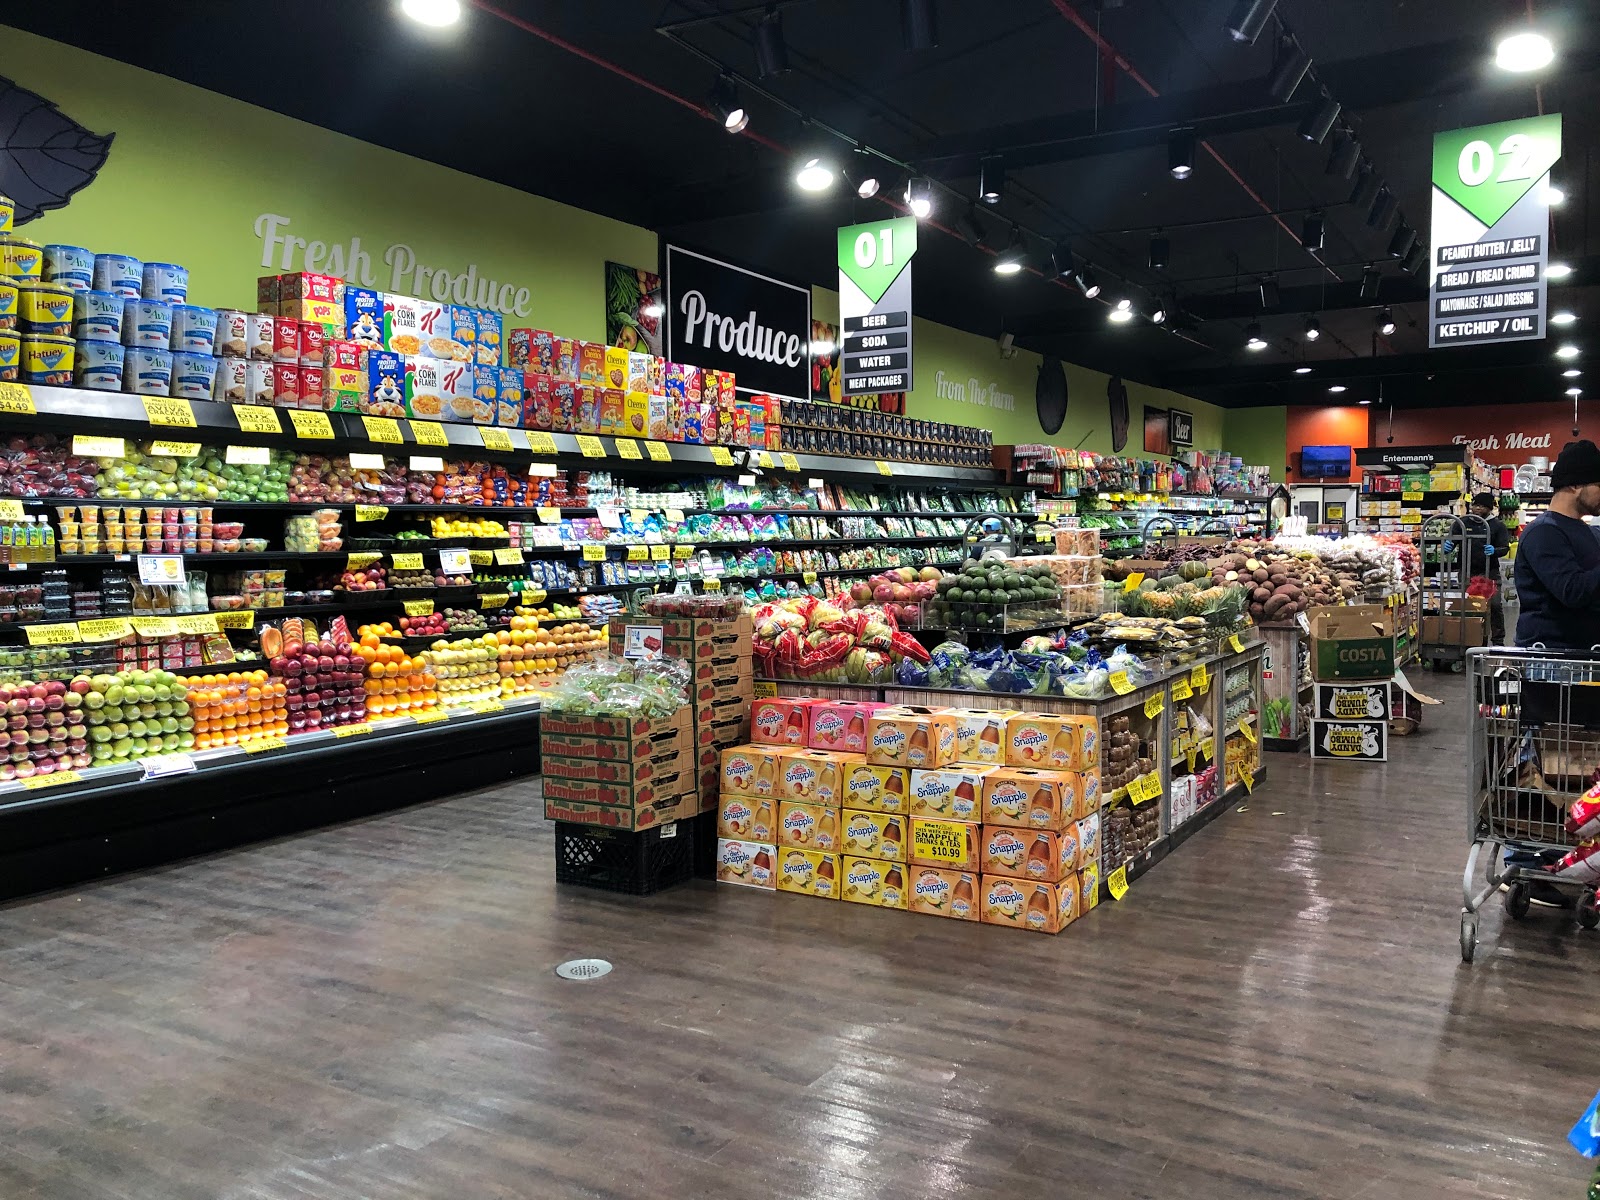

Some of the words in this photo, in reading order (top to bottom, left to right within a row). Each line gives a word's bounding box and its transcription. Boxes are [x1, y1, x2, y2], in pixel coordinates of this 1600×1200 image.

[1458, 133, 1533, 187] 02
[854, 228, 894, 269] 01
[1442, 244, 1472, 261] PEANUT
[1474, 240, 1504, 258] BUTTER
[1510, 238, 1536, 254] JELLY
[4, 254, 36, 263] Hatuey
[254, 213, 377, 287] Fresh
[384, 243, 533, 318] Produce
[1441, 272, 1468, 287] BREAD
[1475, 268, 1503, 283] BREAD
[1505, 265, 1535, 281] CRUMB
[36, 300, 68, 310] Hatuey
[1440, 296, 1479, 312] MAYONNAISE
[1483, 293, 1502, 308] SALAD
[1503, 291, 1534, 306] DRESSING
[313, 305, 330, 317] POPS
[397, 309, 416, 320] CORN
[397, 319, 416, 328] FLAKES
[420, 307, 441, 335] K
[459, 314, 472, 322] RICE
[483, 318, 495, 326] RICE
[862, 314, 887, 328] BEER
[681, 290, 801, 367] Produce
[1439, 321, 1499, 337] KETCHUP
[1502, 319, 1509, 332] /
[1511, 317, 1533, 332] OIL
[862, 335, 887, 348] SODA
[28, 349, 63, 360] Hatuey
[606, 355, 627, 366] Cheerios
[859, 355, 891, 368] WATER
[340, 374, 356, 386] POPS
[418, 370, 437, 380] CORN
[443, 367, 464, 395] K
[480, 372, 493, 380] RICE
[506, 375, 518, 383] RICE
[849, 378, 866, 389] MEAT
[867, 374, 902, 388] PACKAGES
[418, 378, 437, 388] FLAKES
[935, 370, 966, 402] From
[968, 378, 987, 406] The
[989, 383, 1015, 411] Farm
[0, 401, 28, 411] $4.49
[148, 405, 185, 413] AVIVA
[627, 399, 646, 410] Cheerios
[165, 416, 190, 425] $4.49
[308, 428, 329, 436] $6.99
[1174, 415, 1190, 440] Beer
[1452, 434, 1500, 451] Fresh
[1505, 432, 1551, 449] Meat
[1383, 454, 1434, 462] Entenmann's
[1340, 647, 1386, 663] COSTA
[1336, 699, 1369, 708] JUMBO
[1336, 707, 1368, 715] DANDY
[541, 717, 593, 734] Strawberries
[757, 713, 784, 726] Snapple
[815, 718, 844, 731] Snapple
[874, 731, 906, 746] Snapple
[957, 729, 976, 739] pple
[1013, 733, 1048, 747] Snapple
[1330, 735, 1362, 744] JUMBO
[542, 739, 595, 756] Strawberries
[1330, 743, 1362, 752] DANDY
[543, 760, 596, 777] Strawberries
[726, 762, 754, 776] Snapple
[785, 769, 815, 782] Snapple
[849, 776, 880, 790] Snapple
[544, 782, 597, 798] Strawberries
[917, 784, 950, 798] Snapple
[991, 791, 1028, 805] Snapple
[546, 804, 598, 821] Strawberries
[723, 807, 751, 820] Snapple
[784, 816, 814, 828] Snapple
[848, 824, 878, 837] Snapple
[915, 831, 959, 842] SNAPPLE
[915, 837, 938, 845] DRINKS
[946, 840, 960, 848] TEAS
[989, 841, 1025, 854] Snapple
[931, 846, 960, 858] $10.99
[723, 853, 750, 865] Snapple
[784, 861, 813, 873] Snapple
[848, 871, 880, 883] Snapple
[916, 881, 949, 894] Snapple
[989, 891, 1024, 904] Snapple
